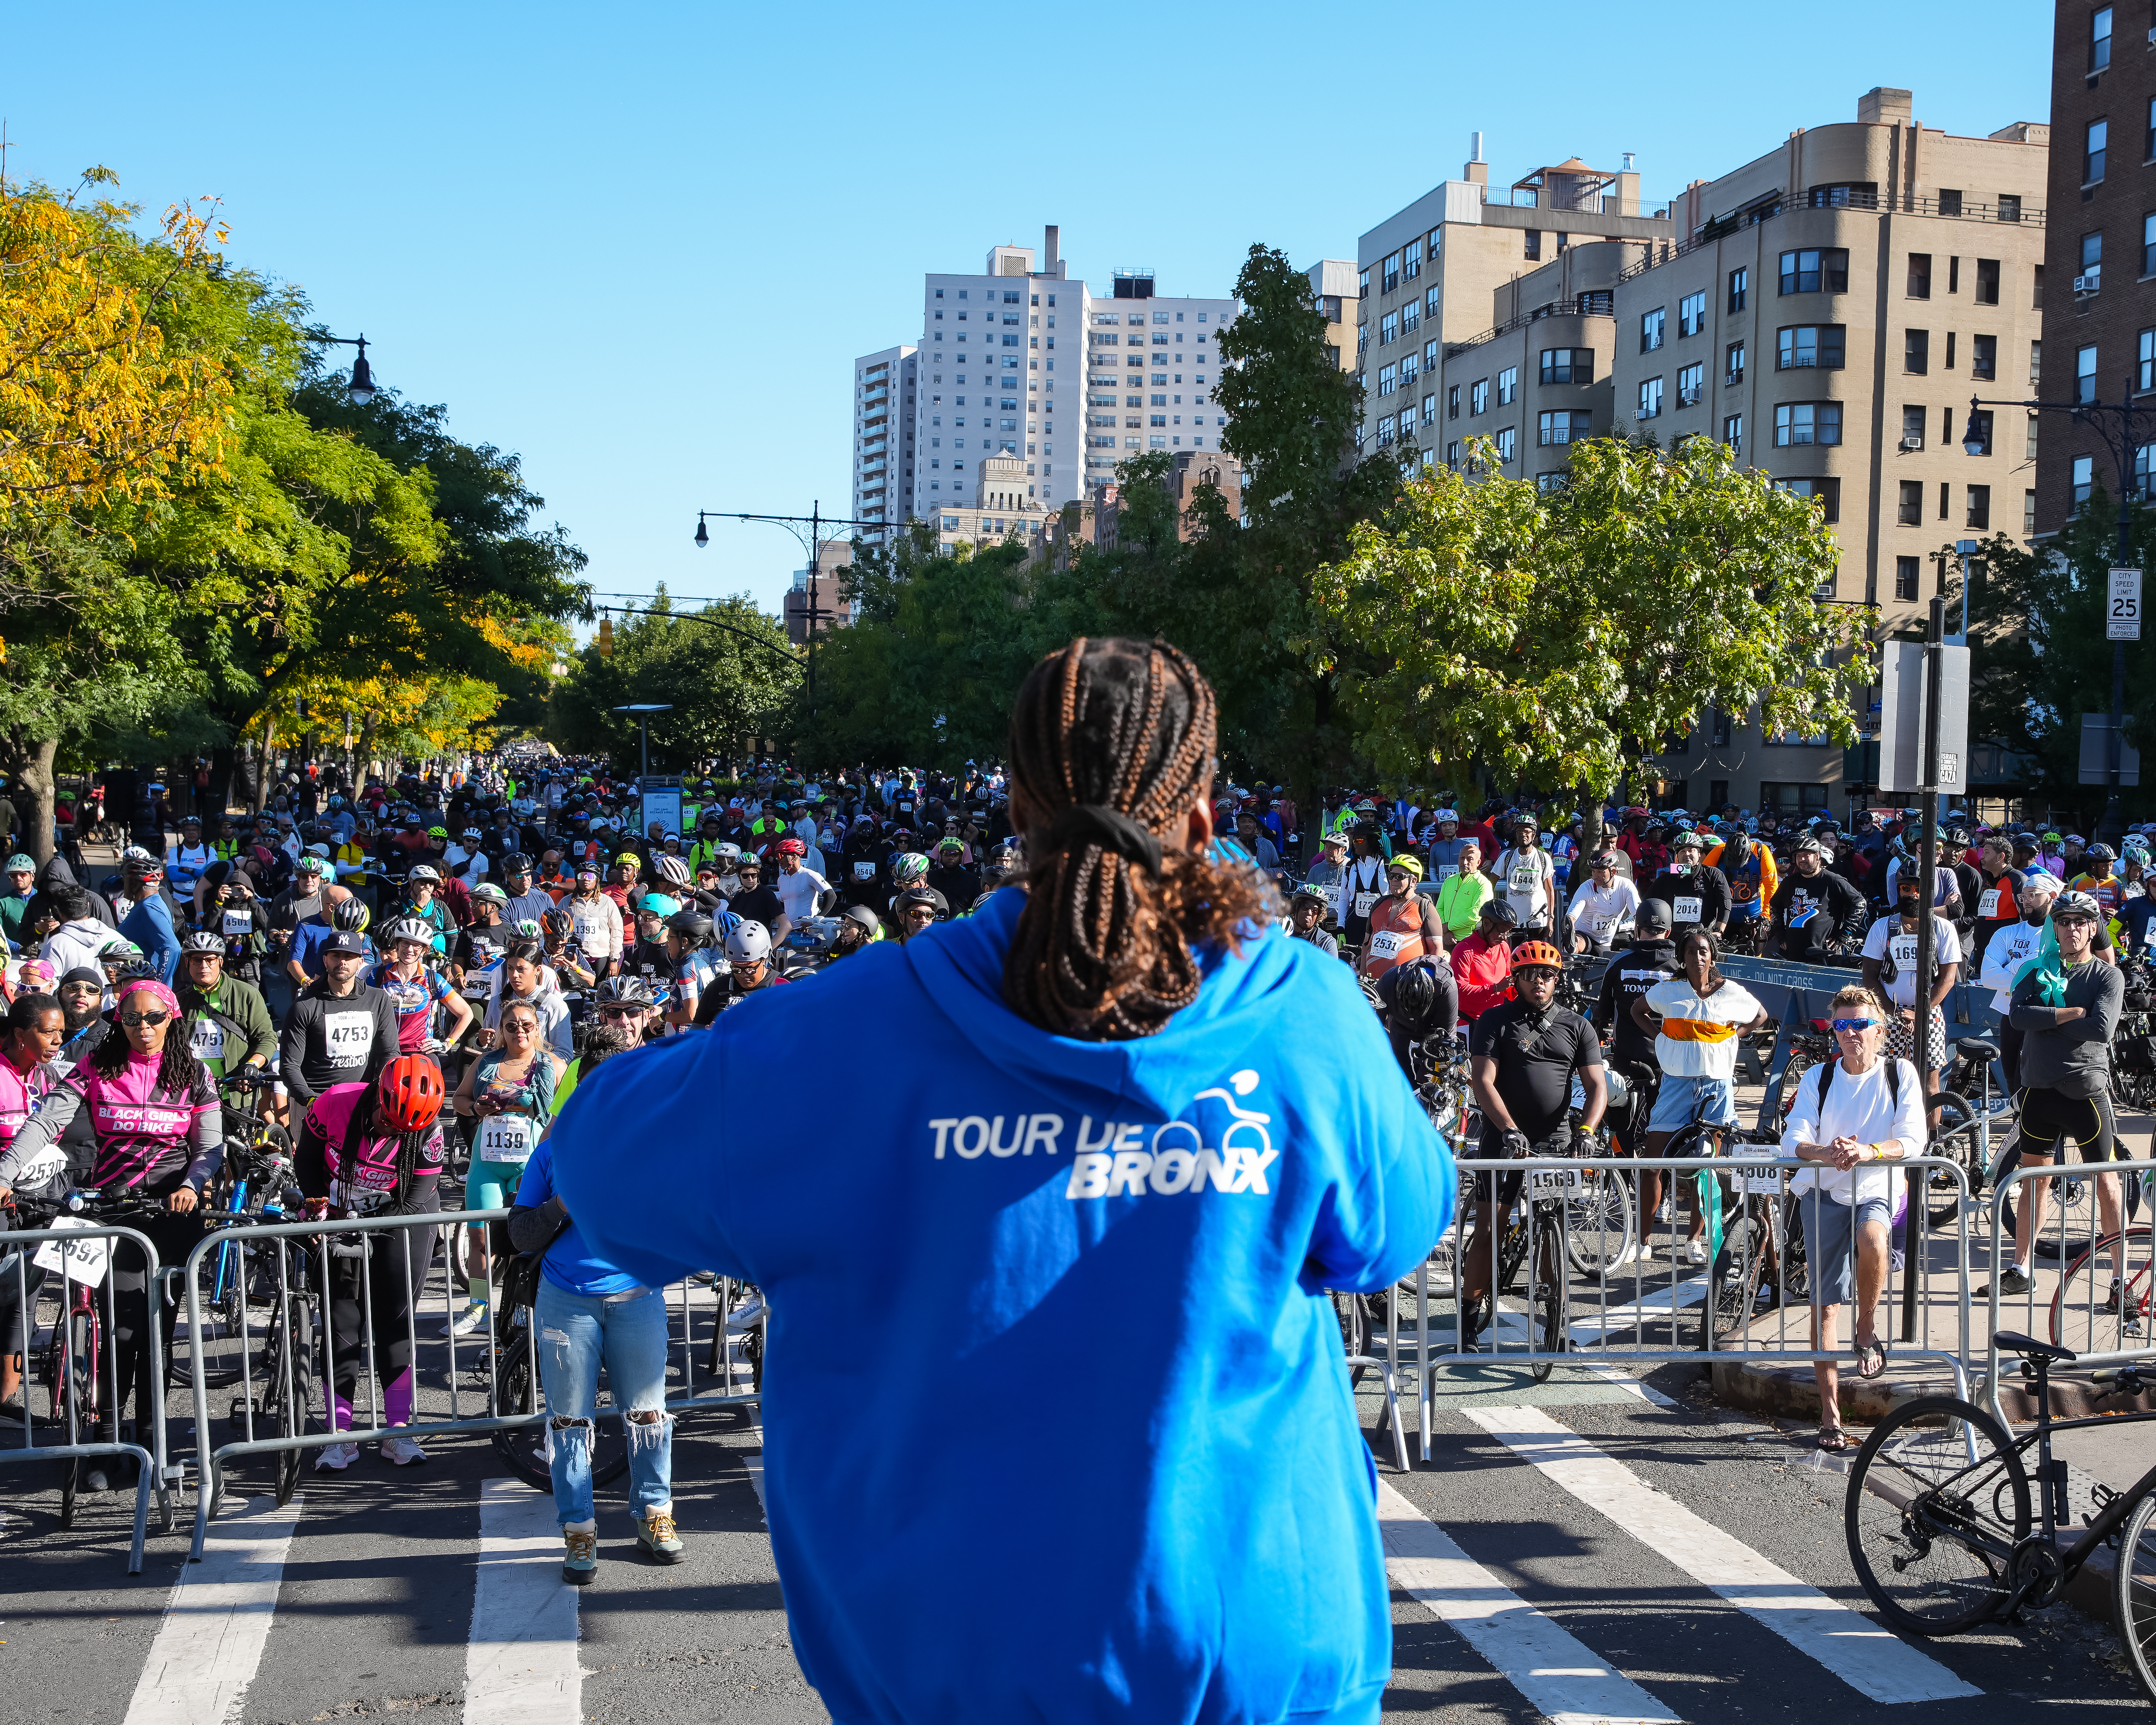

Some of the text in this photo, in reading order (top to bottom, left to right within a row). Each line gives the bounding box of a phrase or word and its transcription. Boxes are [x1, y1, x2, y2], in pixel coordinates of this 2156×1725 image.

[2112, 599, 2137, 617] 25
[1940, 771, 1956, 783] GAZA
[1513, 875, 1533, 885] 1644
[1980, 898, 1995, 908] 2013
[1676, 905, 1698, 915] 2014
[226, 918, 248, 926] 4501
[576, 925, 596, 934] 1393
[338, 934, 350, 945] NY
[1374, 938, 1397, 952] 2531
[641, 964, 655, 973] TOUR
[1726, 968, 1742, 977] LINE
[1755, 972, 1765, 981] DO
[1768, 973, 1783, 983] NOT
[1787, 975, 1813, 988] CROSS
[1623, 984, 1653, 993] TOM'
[193, 1033, 223, 1047] 4751
[332, 1026, 368, 1042] 4753
[1980, 1098, 2009, 1110] EPT
[99, 1107, 189, 1122] BLACK GIRLS
[113, 1121, 174, 1133] DO BIKE
[486, 1132, 523, 1149] 1139
[929, 1114, 1144, 1159] TOUR DE
[1066, 1148, 1280, 1199] BRONX
[1532, 1171, 1576, 1188] 1569
[354, 1177, 391, 1189] BIKE
